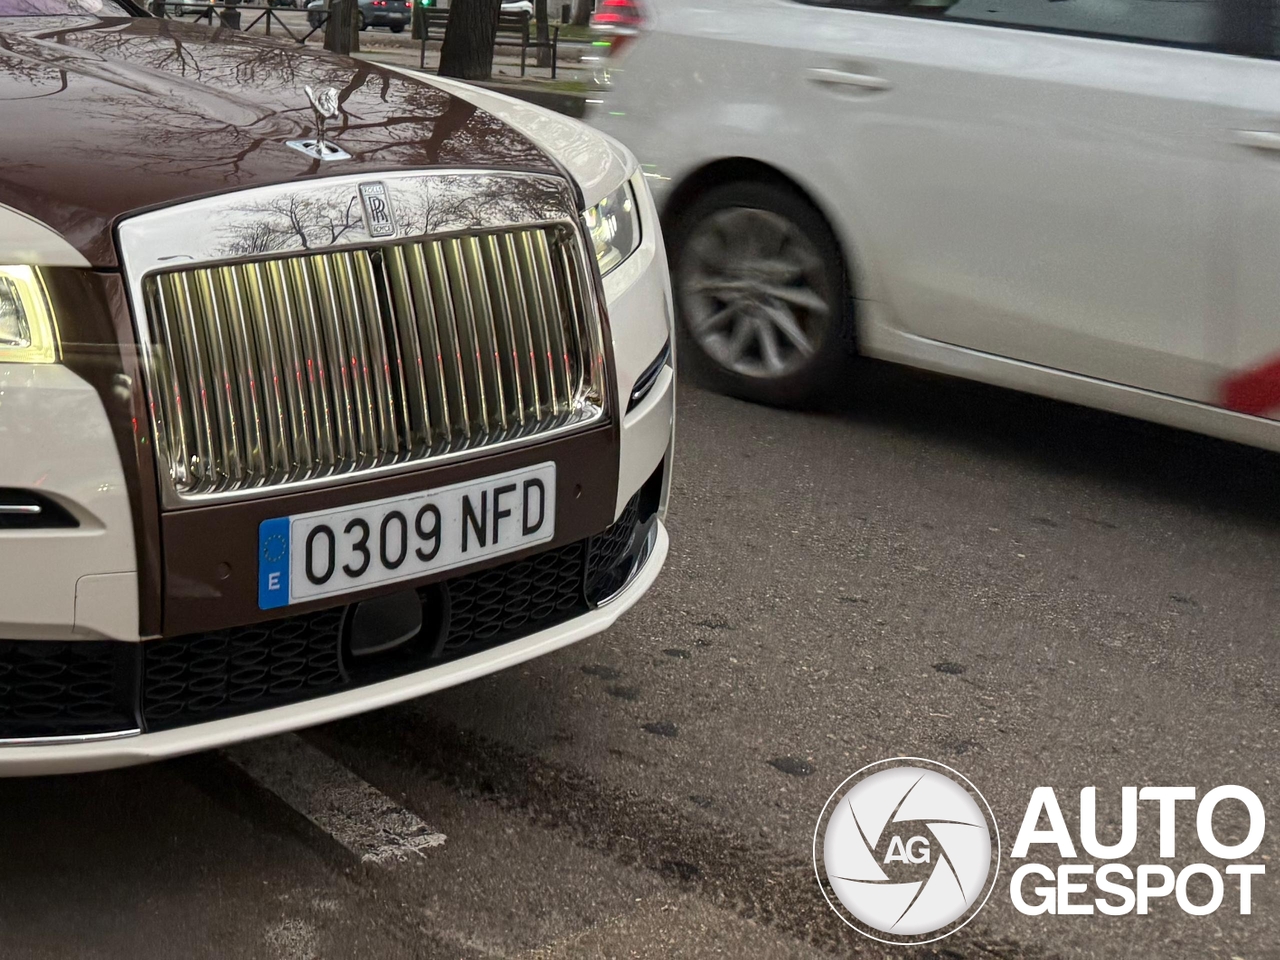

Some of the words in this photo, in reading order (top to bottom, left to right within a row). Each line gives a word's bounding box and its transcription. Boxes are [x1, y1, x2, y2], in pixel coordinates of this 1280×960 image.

[305, 502, 442, 586] 0309
[460, 477, 546, 553] NFD
[267, 571, 281, 591] E
